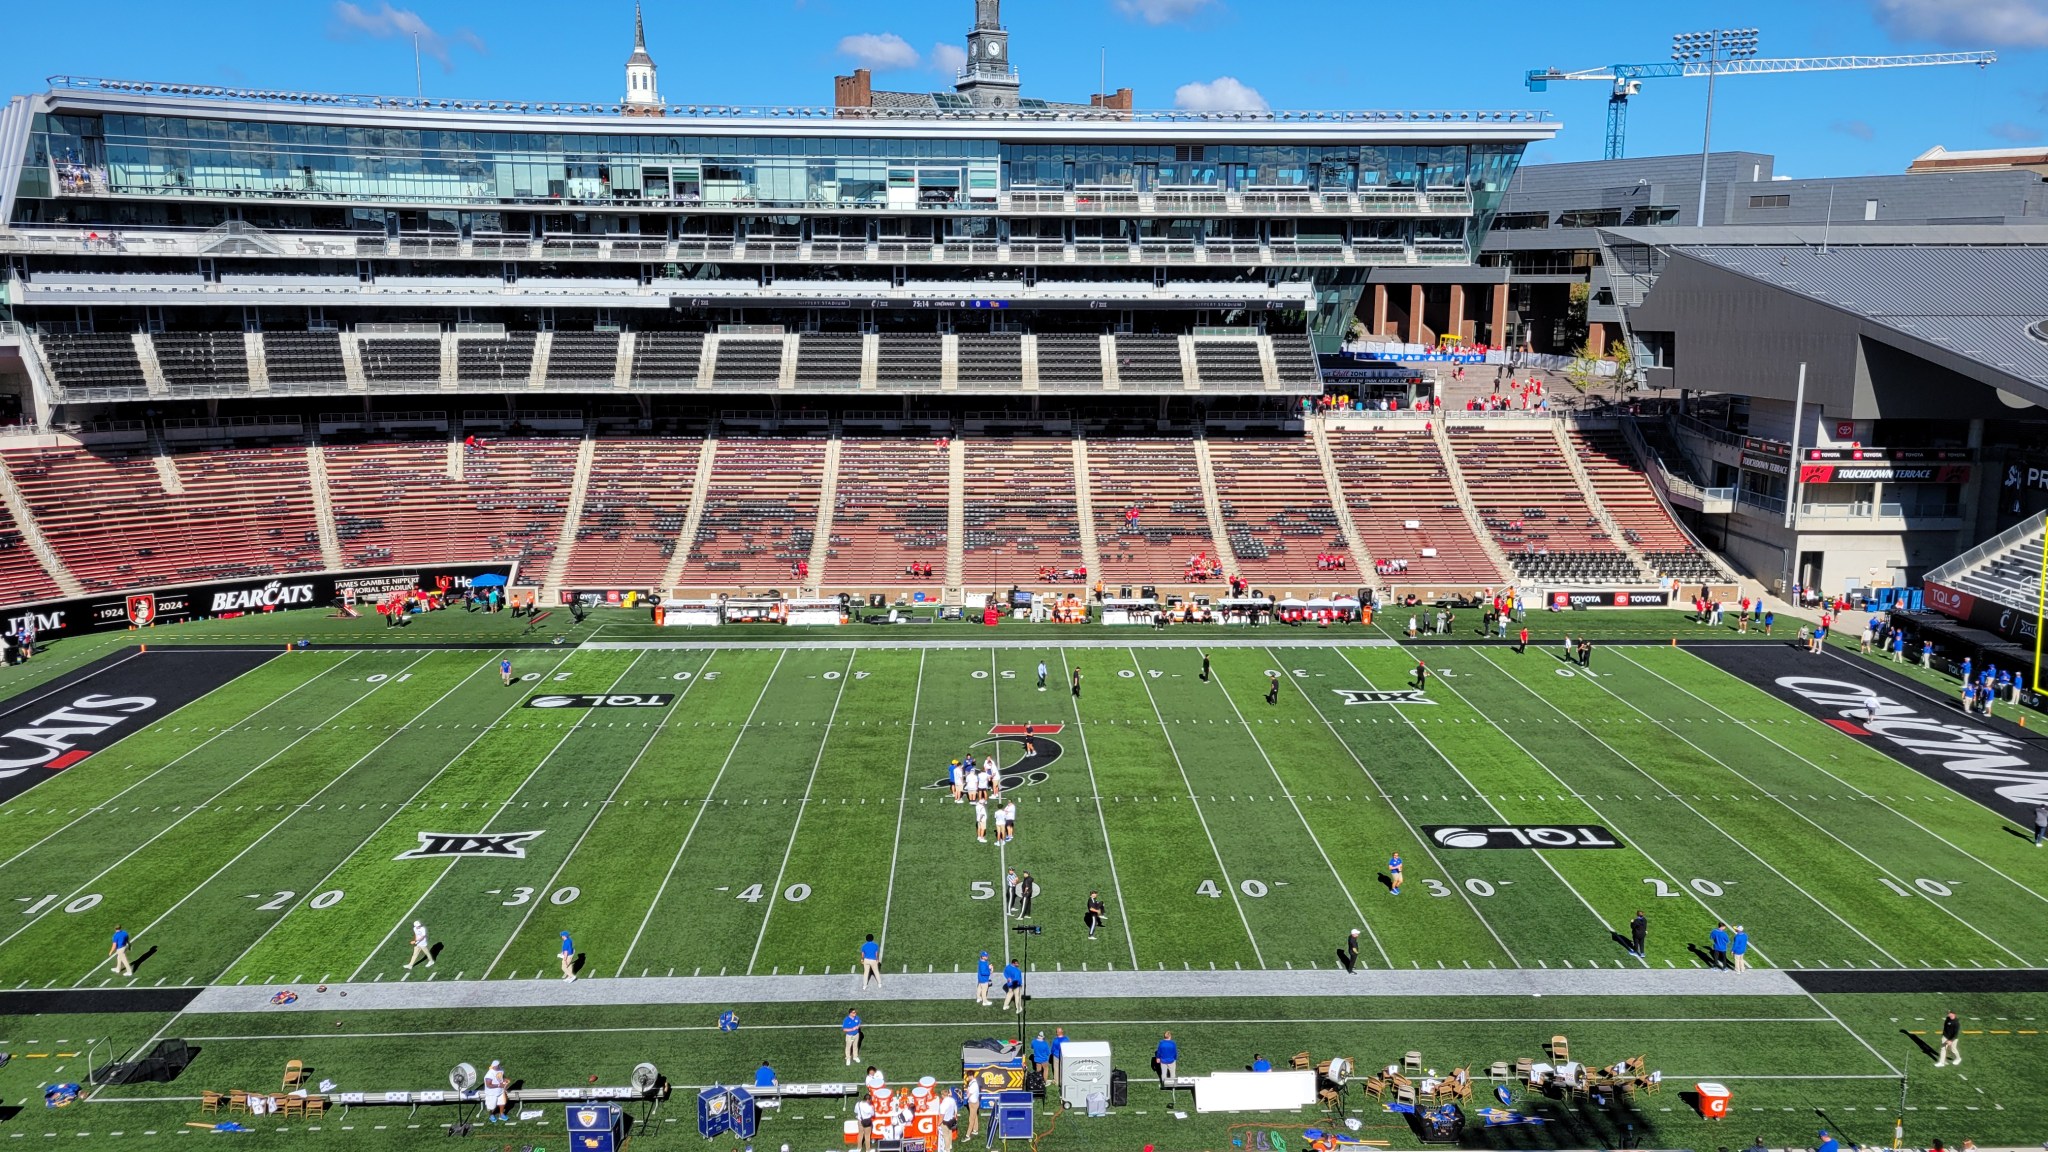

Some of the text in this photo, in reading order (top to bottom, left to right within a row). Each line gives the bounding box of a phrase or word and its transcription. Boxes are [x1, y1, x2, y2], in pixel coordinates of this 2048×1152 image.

[1742, 456, 1789, 475] TOUCHDOWN TERRACE
[1837, 469, 1932, 479] TOUCHDOWN TERRACE
[335, 580, 358, 590] JAMES
[360, 579, 391, 587] GAMBLE
[381, 584, 414, 592] STADIUM
[211, 582, 314, 612] BEARCATS
[1570, 595, 1601, 603] TOYOTA
[1630, 595, 1661, 603] TOYOTA
[1931, 588, 1950, 606] TQL
[100, 607, 125, 618] 1924
[158, 601, 183, 612] 2024
[0, 694, 157, 778] CATS
[1076, 1064, 1100, 1072] ACC
[981, 1071, 1005, 1085] Pitt
[1711, 1099, 1724, 1112] G
[872, 1119, 885, 1135] G
[918, 1118, 933, 1134] G
